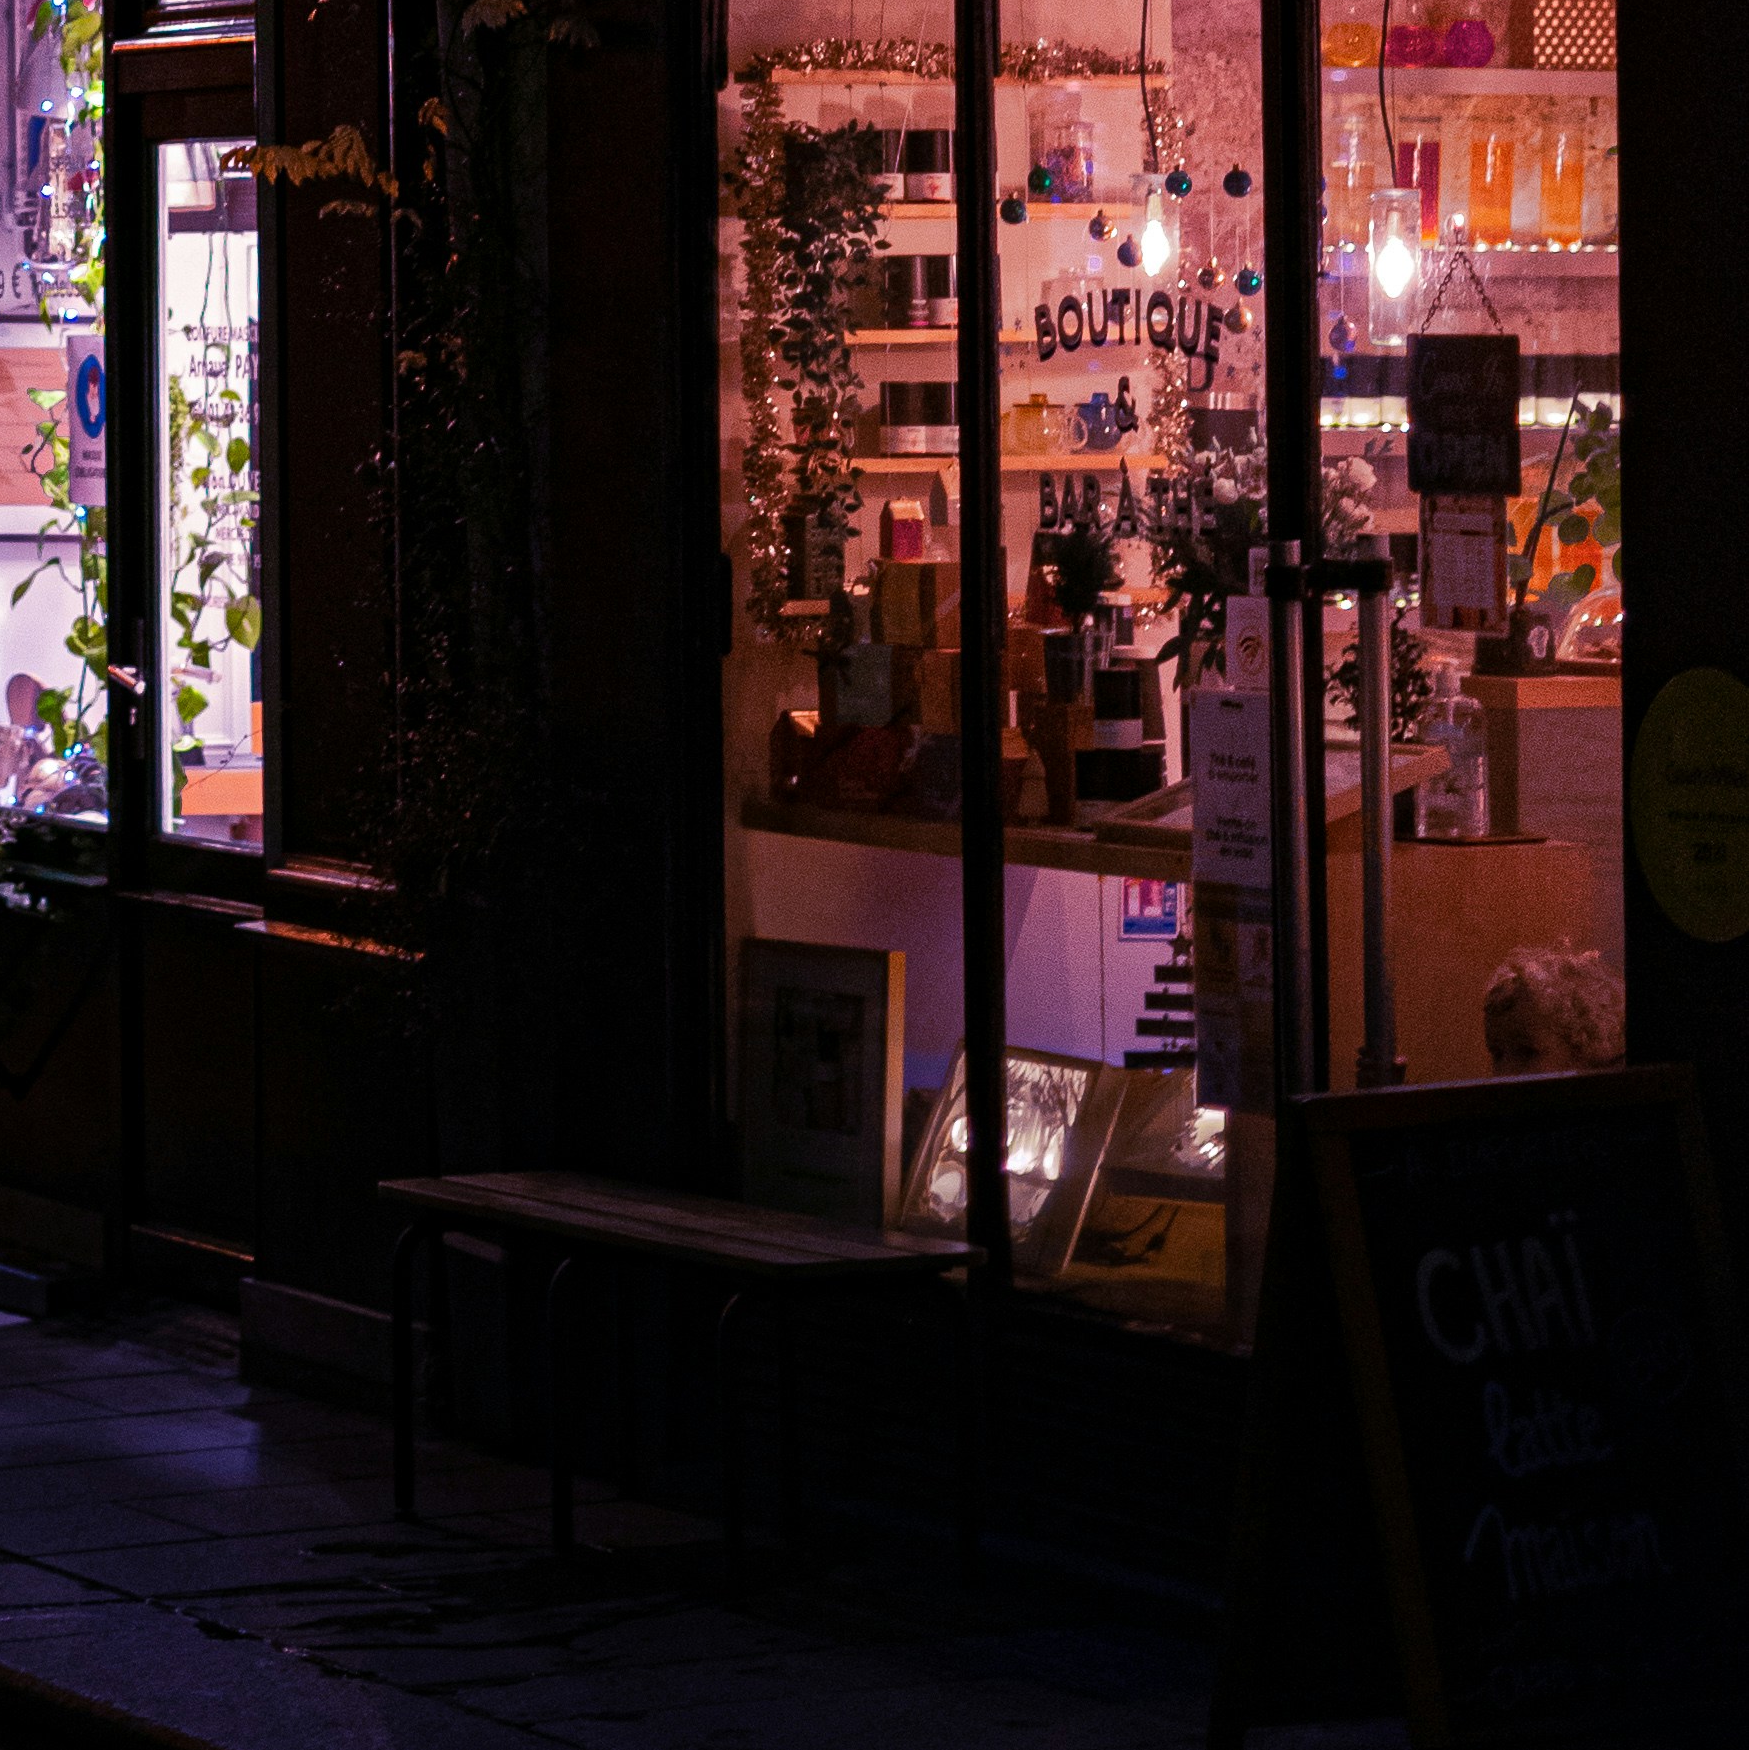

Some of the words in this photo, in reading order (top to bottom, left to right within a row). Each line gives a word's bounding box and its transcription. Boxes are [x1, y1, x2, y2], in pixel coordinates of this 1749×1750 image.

[1034, 288, 1224, 364] BOUTIQUE
[1114, 375, 1139, 433] &
[1038, 471, 1102, 531] BAR
[1113, 454, 1139, 535] À
[1414, 1207, 1598, 1366] CHAÏ
